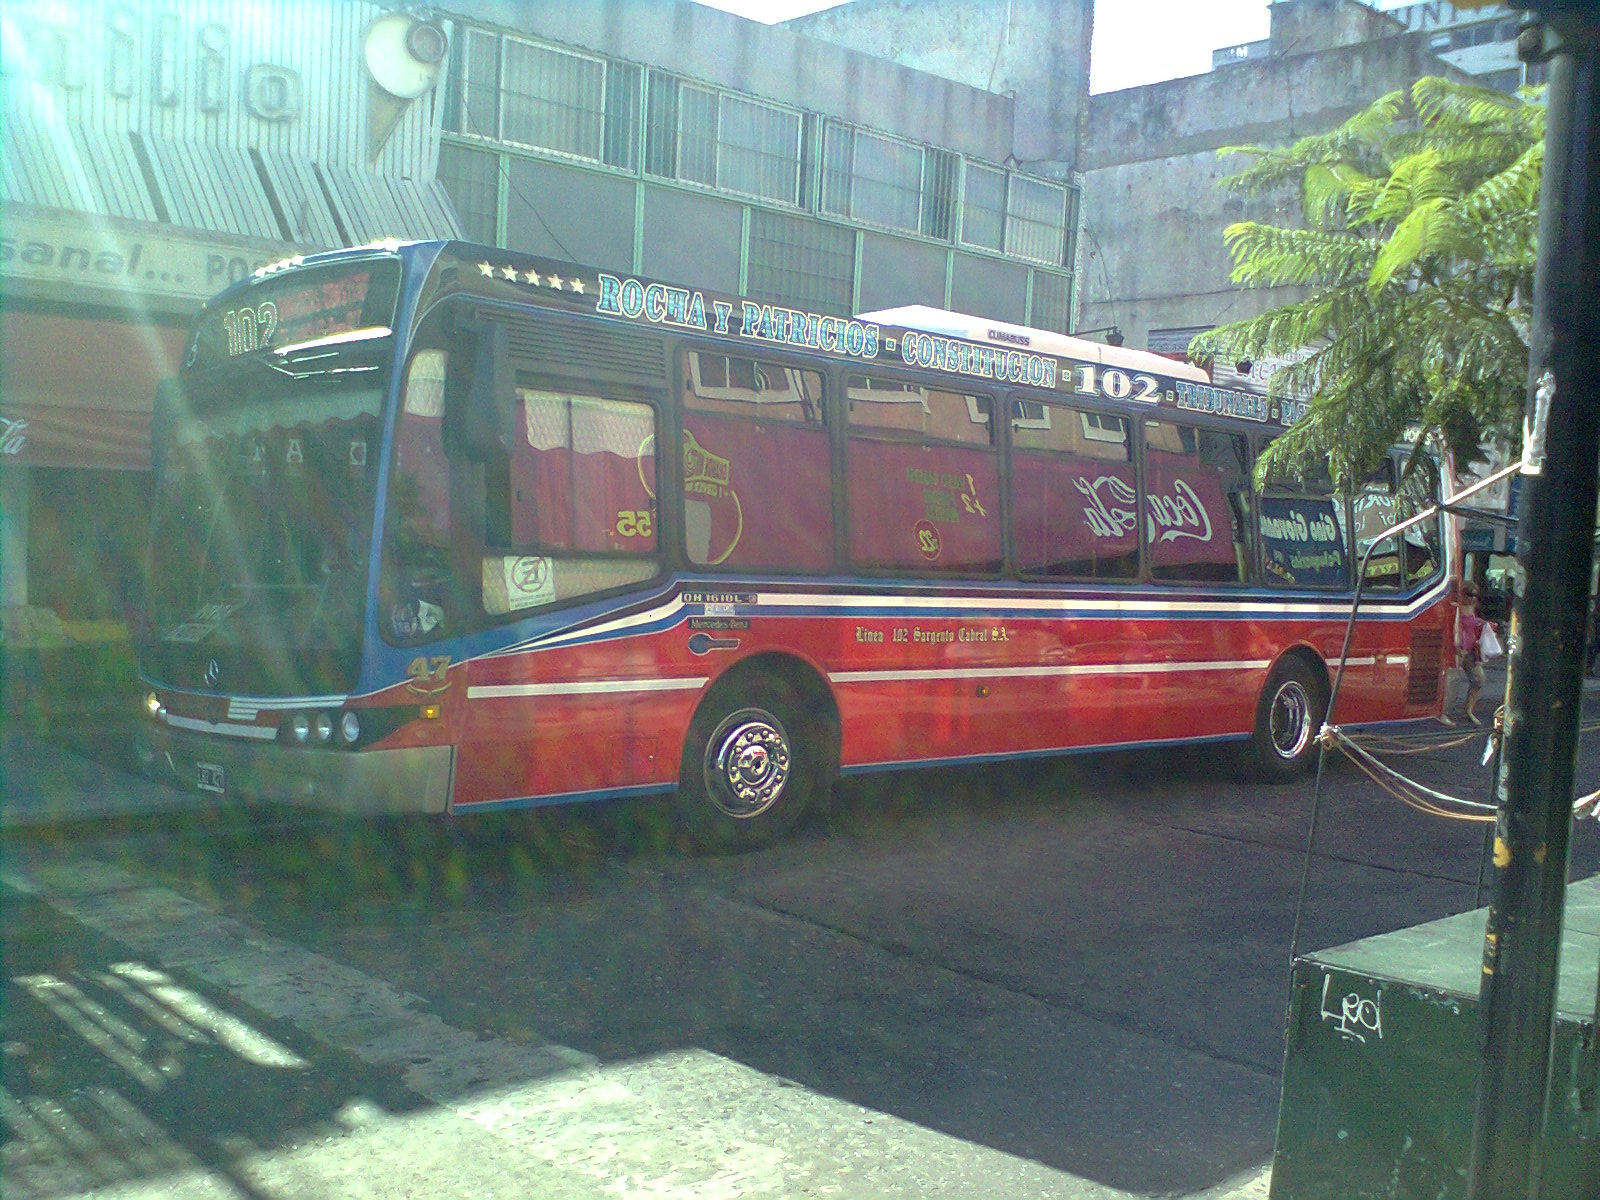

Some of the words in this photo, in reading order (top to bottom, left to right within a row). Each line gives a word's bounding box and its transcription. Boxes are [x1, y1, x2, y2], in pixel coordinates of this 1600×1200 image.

[224, 301, 278, 356] 102
[596, 272, 708, 330] ROCHA
[713, 301, 733, 334] Y
[740, 300, 880, 359] PATRICIOS
[900, 331, 1058, 389] CONSTITUCION
[1074, 363, 1163, 404] 102
[892, 627, 909, 643] 102
[913, 626, 954, 645] Sargento
[958, 627, 987, 642] Cabral
[406, 655, 451, 682] 47
